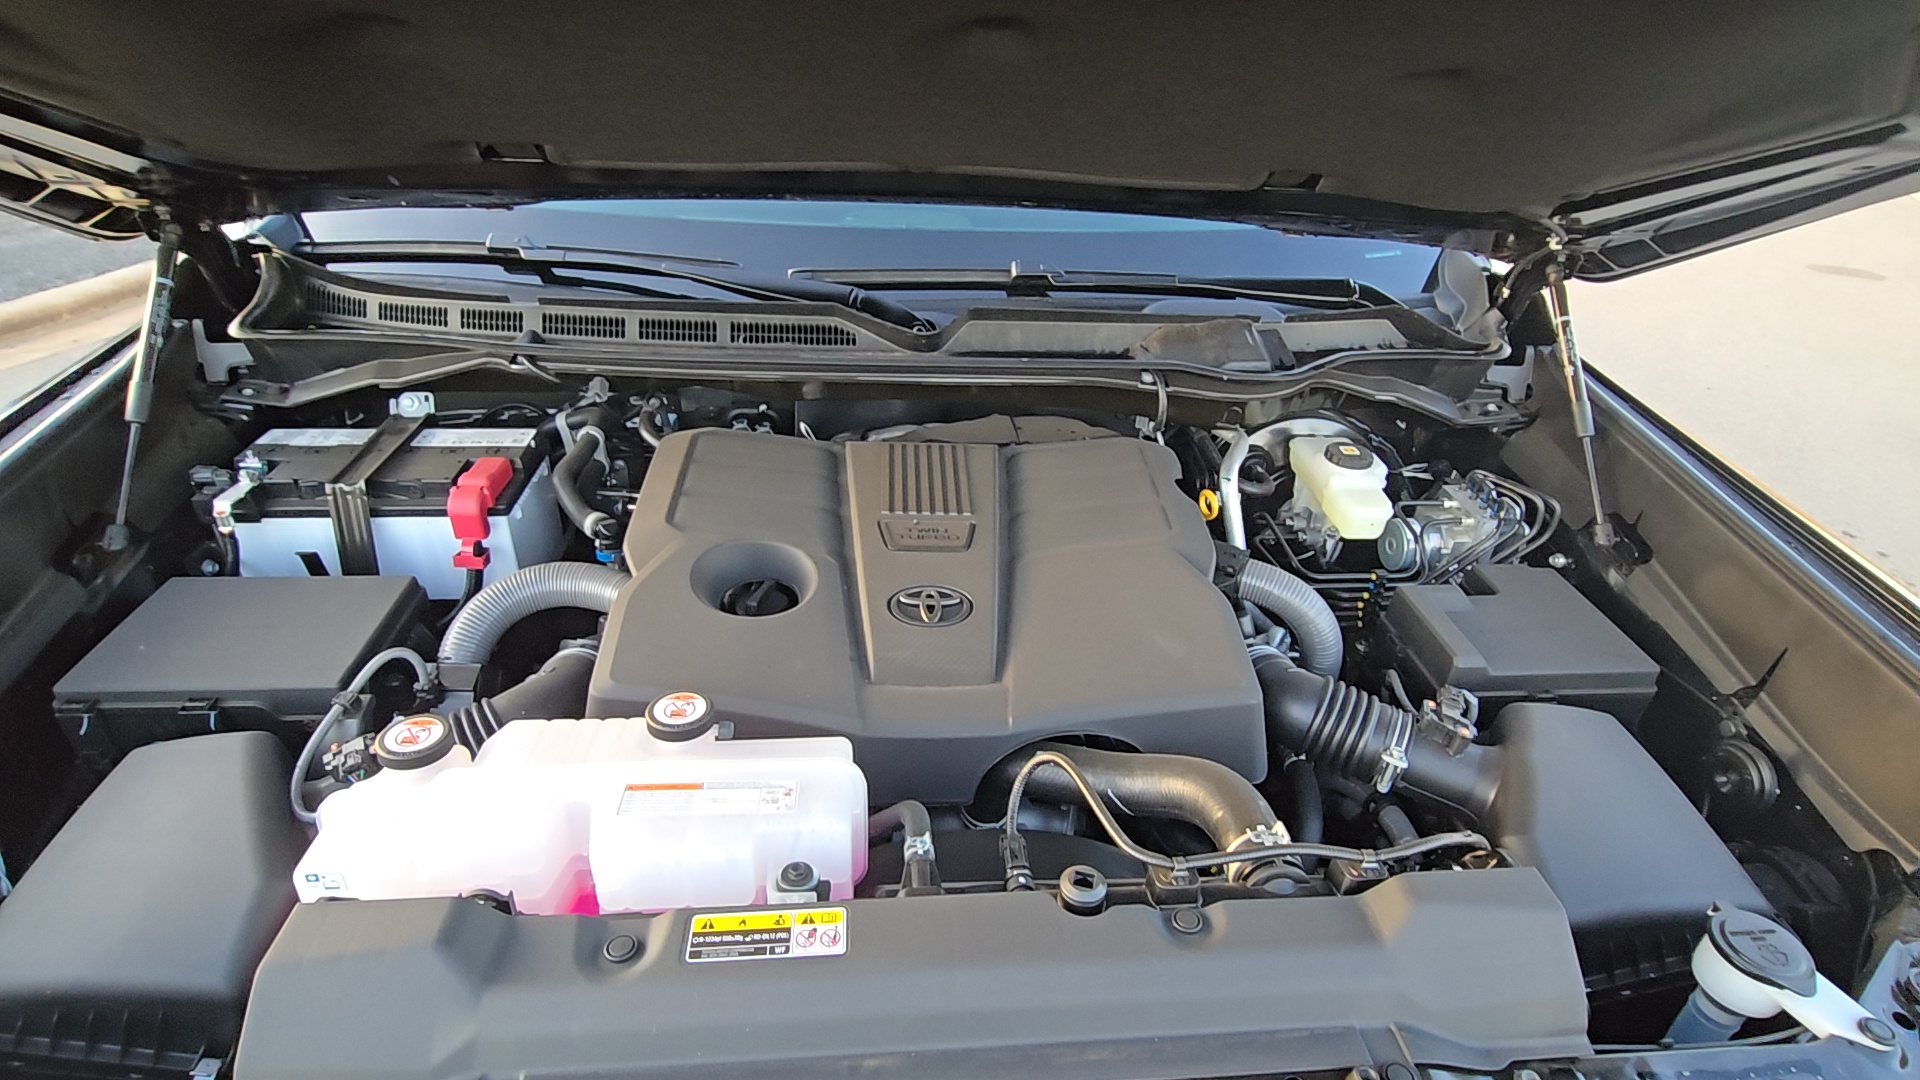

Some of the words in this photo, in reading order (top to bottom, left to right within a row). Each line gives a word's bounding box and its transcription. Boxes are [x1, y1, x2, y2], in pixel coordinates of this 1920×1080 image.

[904, 526, 949, 534] TWIN
[896, 533, 961, 541] TURBO
[774, 946, 787, 954] WF
